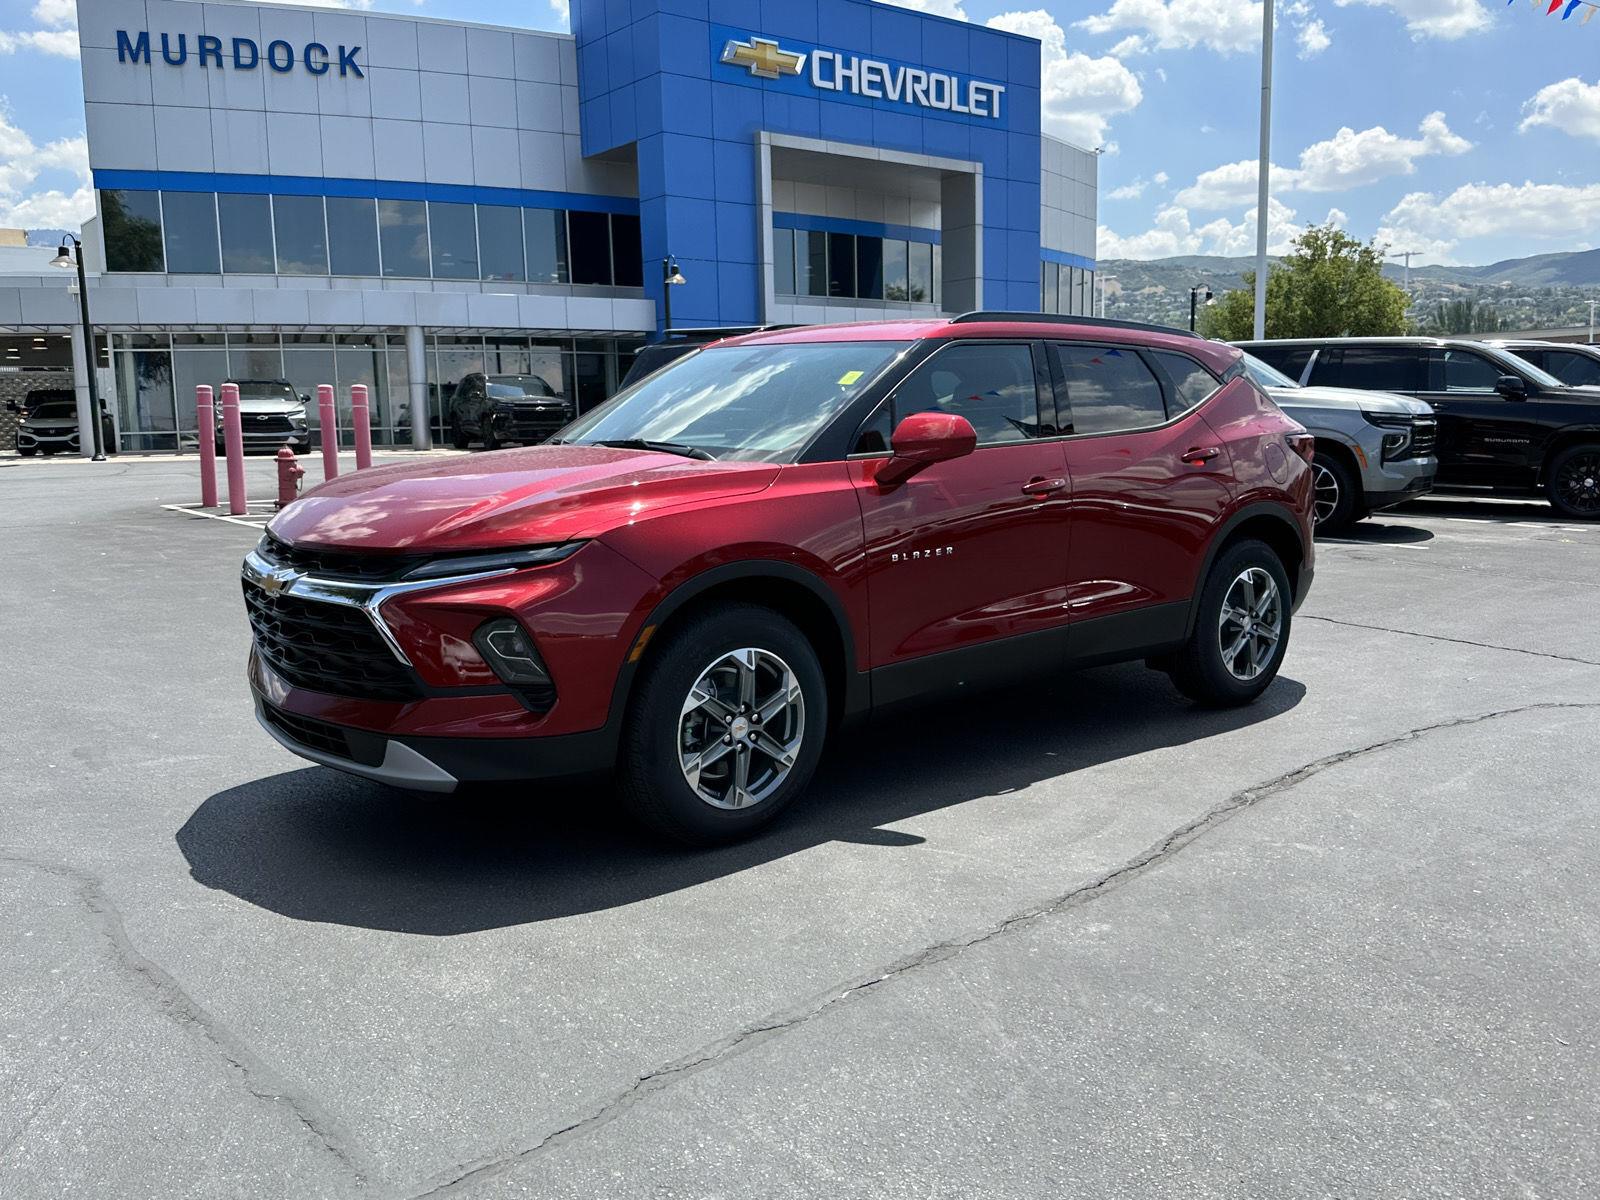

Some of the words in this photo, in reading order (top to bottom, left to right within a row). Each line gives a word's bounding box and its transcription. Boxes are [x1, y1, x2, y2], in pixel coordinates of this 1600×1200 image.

[116, 30, 365, 78] MURDOCK
[811, 50, 1006, 118] CHEVROLET
[891, 546, 953, 562] BLAZER
